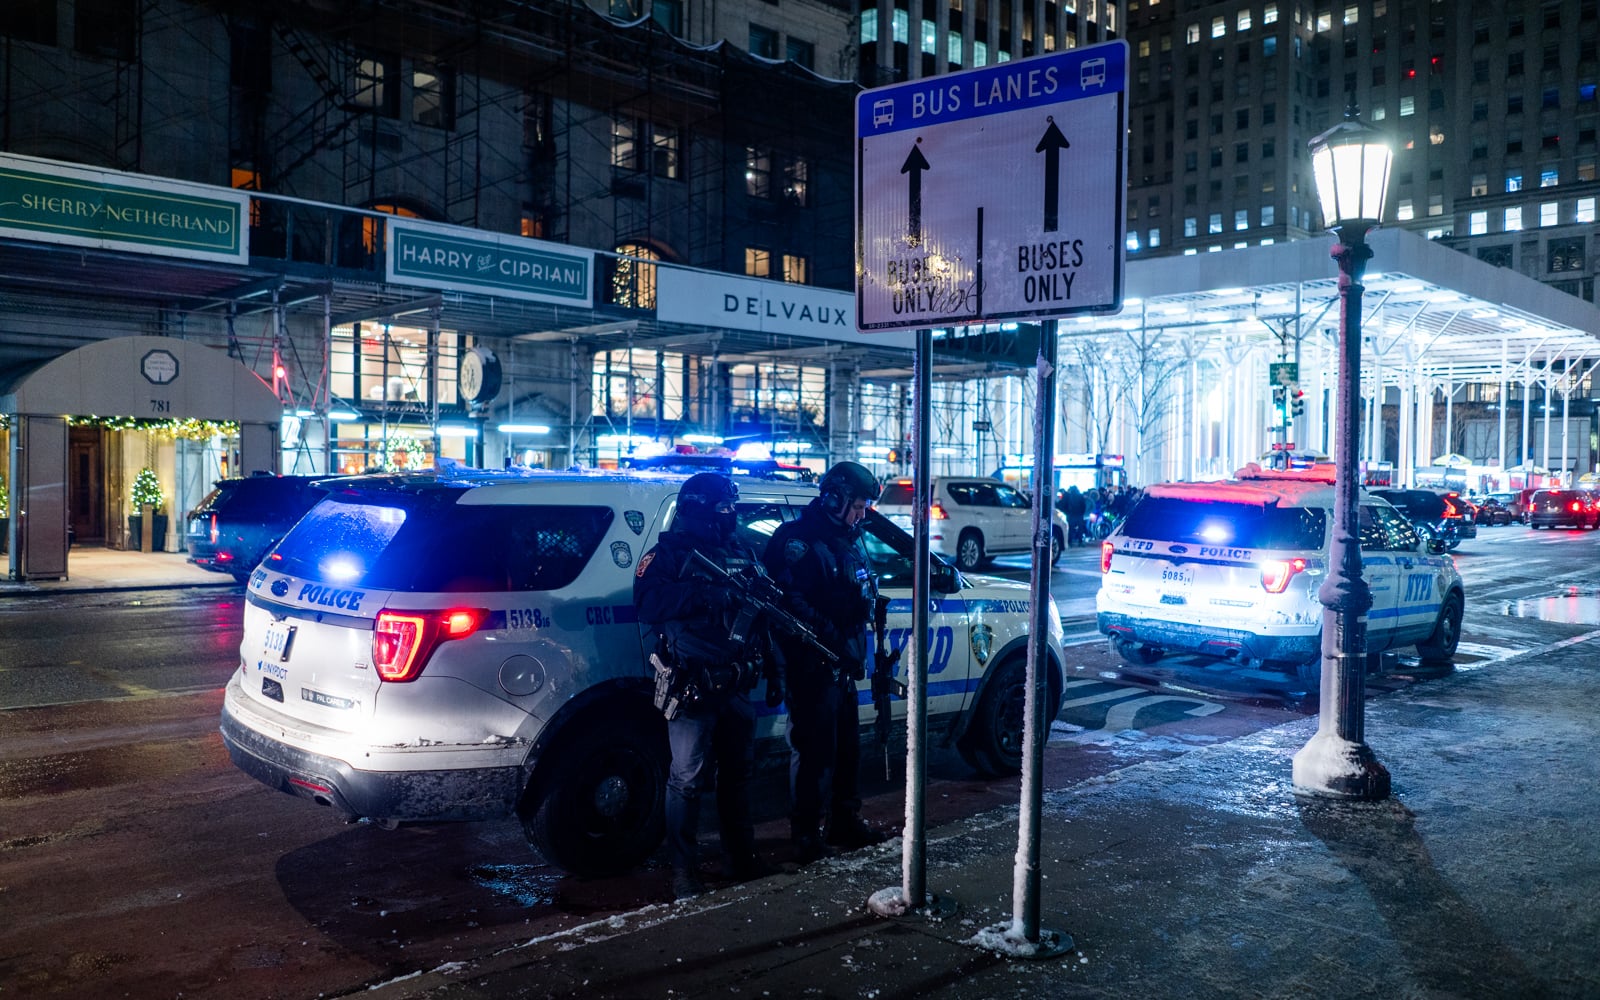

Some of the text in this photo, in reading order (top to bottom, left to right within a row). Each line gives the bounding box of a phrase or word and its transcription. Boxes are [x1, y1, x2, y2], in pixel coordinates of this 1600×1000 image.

[912, 66, 1059, 118] BUS LANES
[21, 193, 231, 235] SHERRY-NETHERLAND
[402, 243, 473, 269] HARRY
[499, 258, 581, 286] CIPRIANI
[1018, 239, 1083, 273] BUSES
[893, 285, 936, 314] ONLY
[1024, 272, 1076, 303] ONLY
[724, 293, 847, 327] DELVAUX
[150, 399, 170, 412] 781
[1199, 546, 1252, 560] POLICE
[1162, 570, 1184, 581] 5085
[1404, 573, 1433, 602] NYPD
[297, 583, 366, 611] POLICE
[1005, 600, 1032, 613] POLIC
[510, 608, 542, 628] 5138
